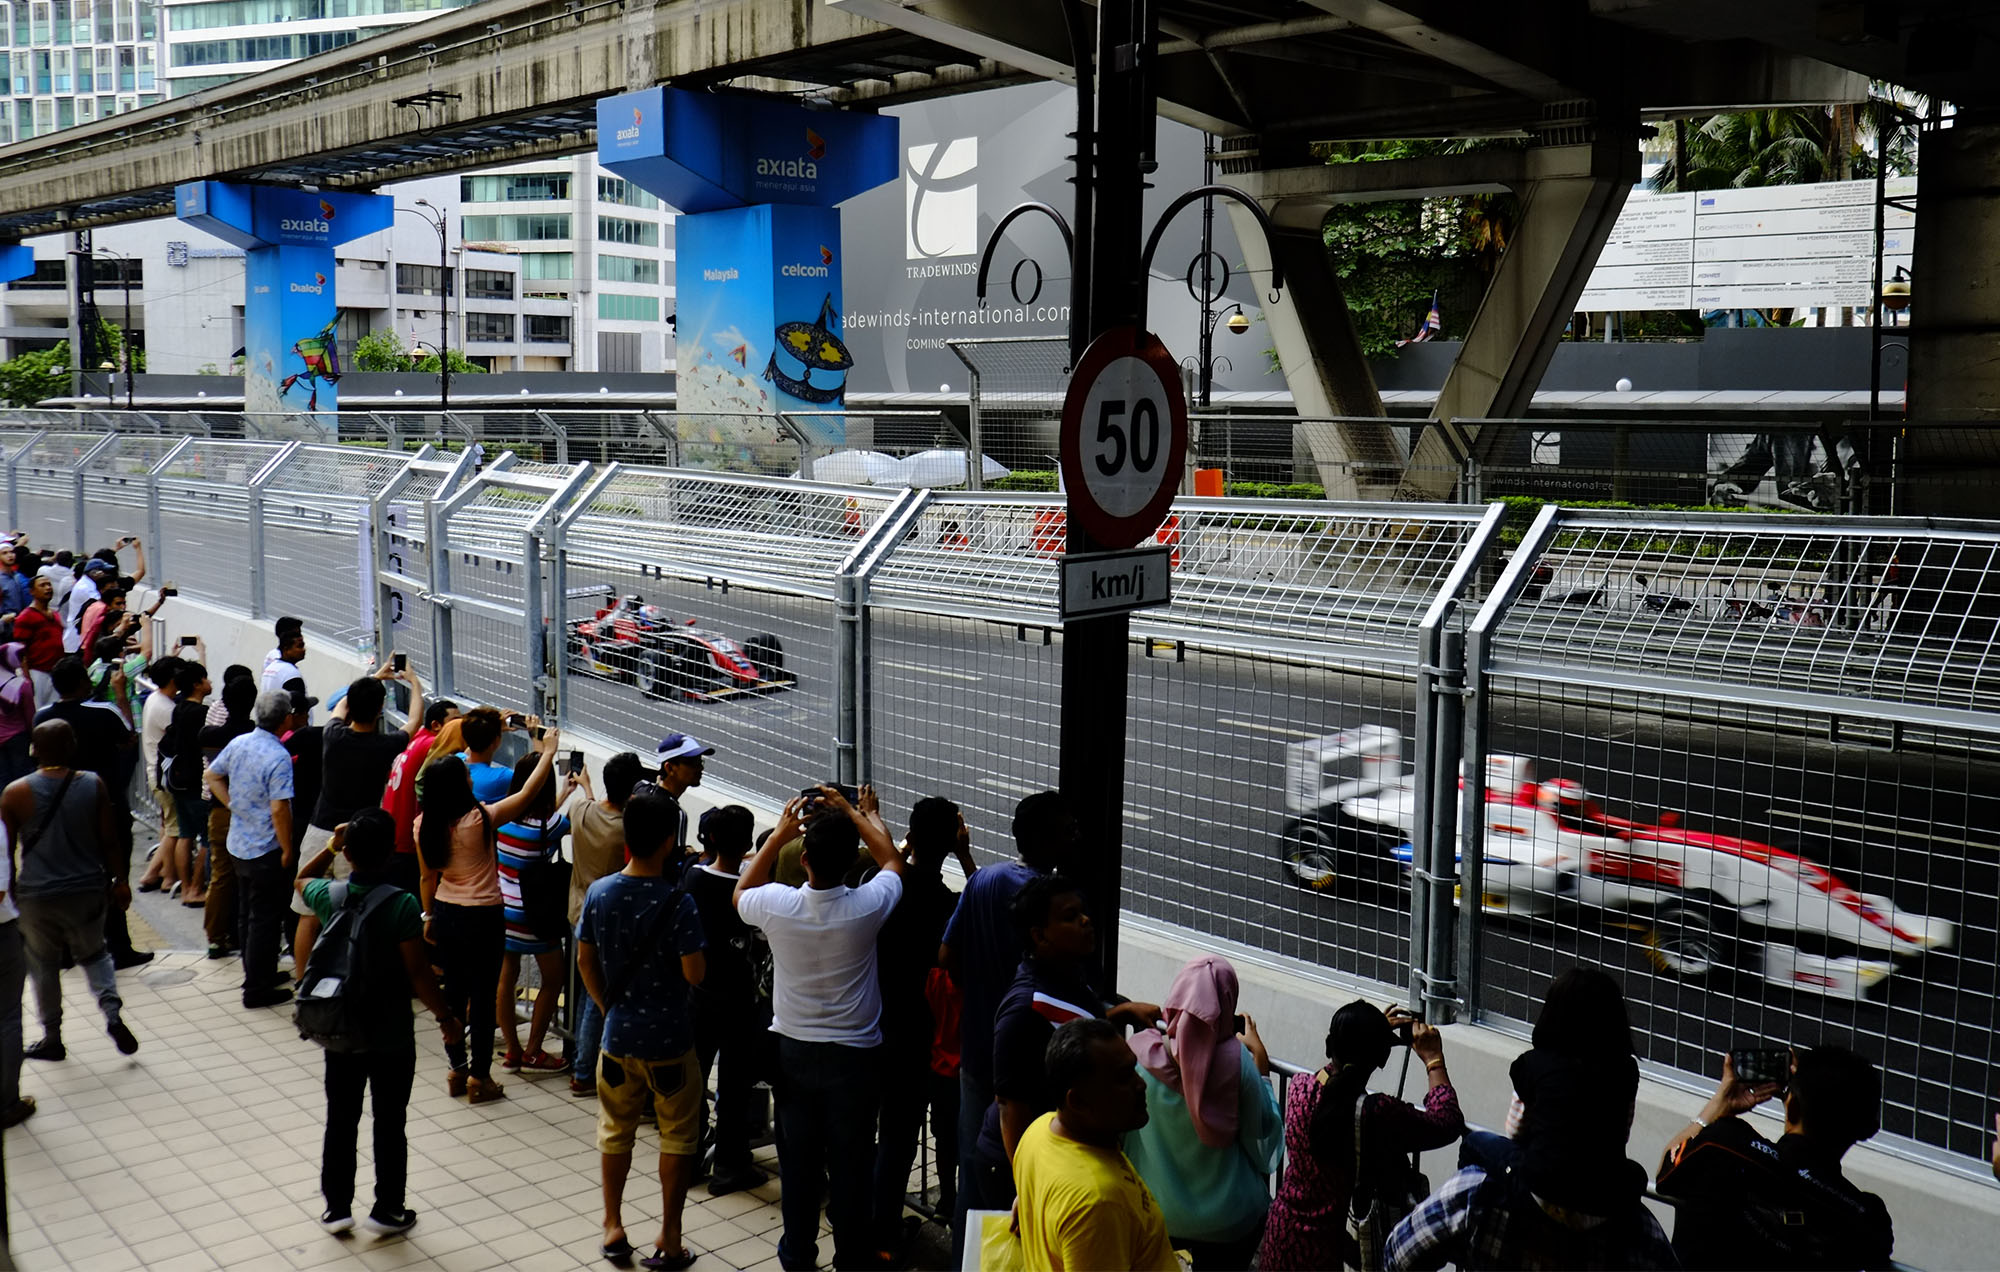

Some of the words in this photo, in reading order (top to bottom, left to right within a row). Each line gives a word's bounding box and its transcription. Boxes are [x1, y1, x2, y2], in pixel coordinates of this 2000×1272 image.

[756, 157, 817, 179] axiata
[280, 218, 329, 233] axiata
[704, 267, 739, 282] Malaysia
[781, 263, 829, 278] celcom
[906, 262, 978, 279] TRADEWINDS
[290, 282, 322, 295] Dialog
[906, 338, 945, 350] COMING
[1095, 397, 1160, 477] 50
[1091, 564, 1145, 601] km/j
